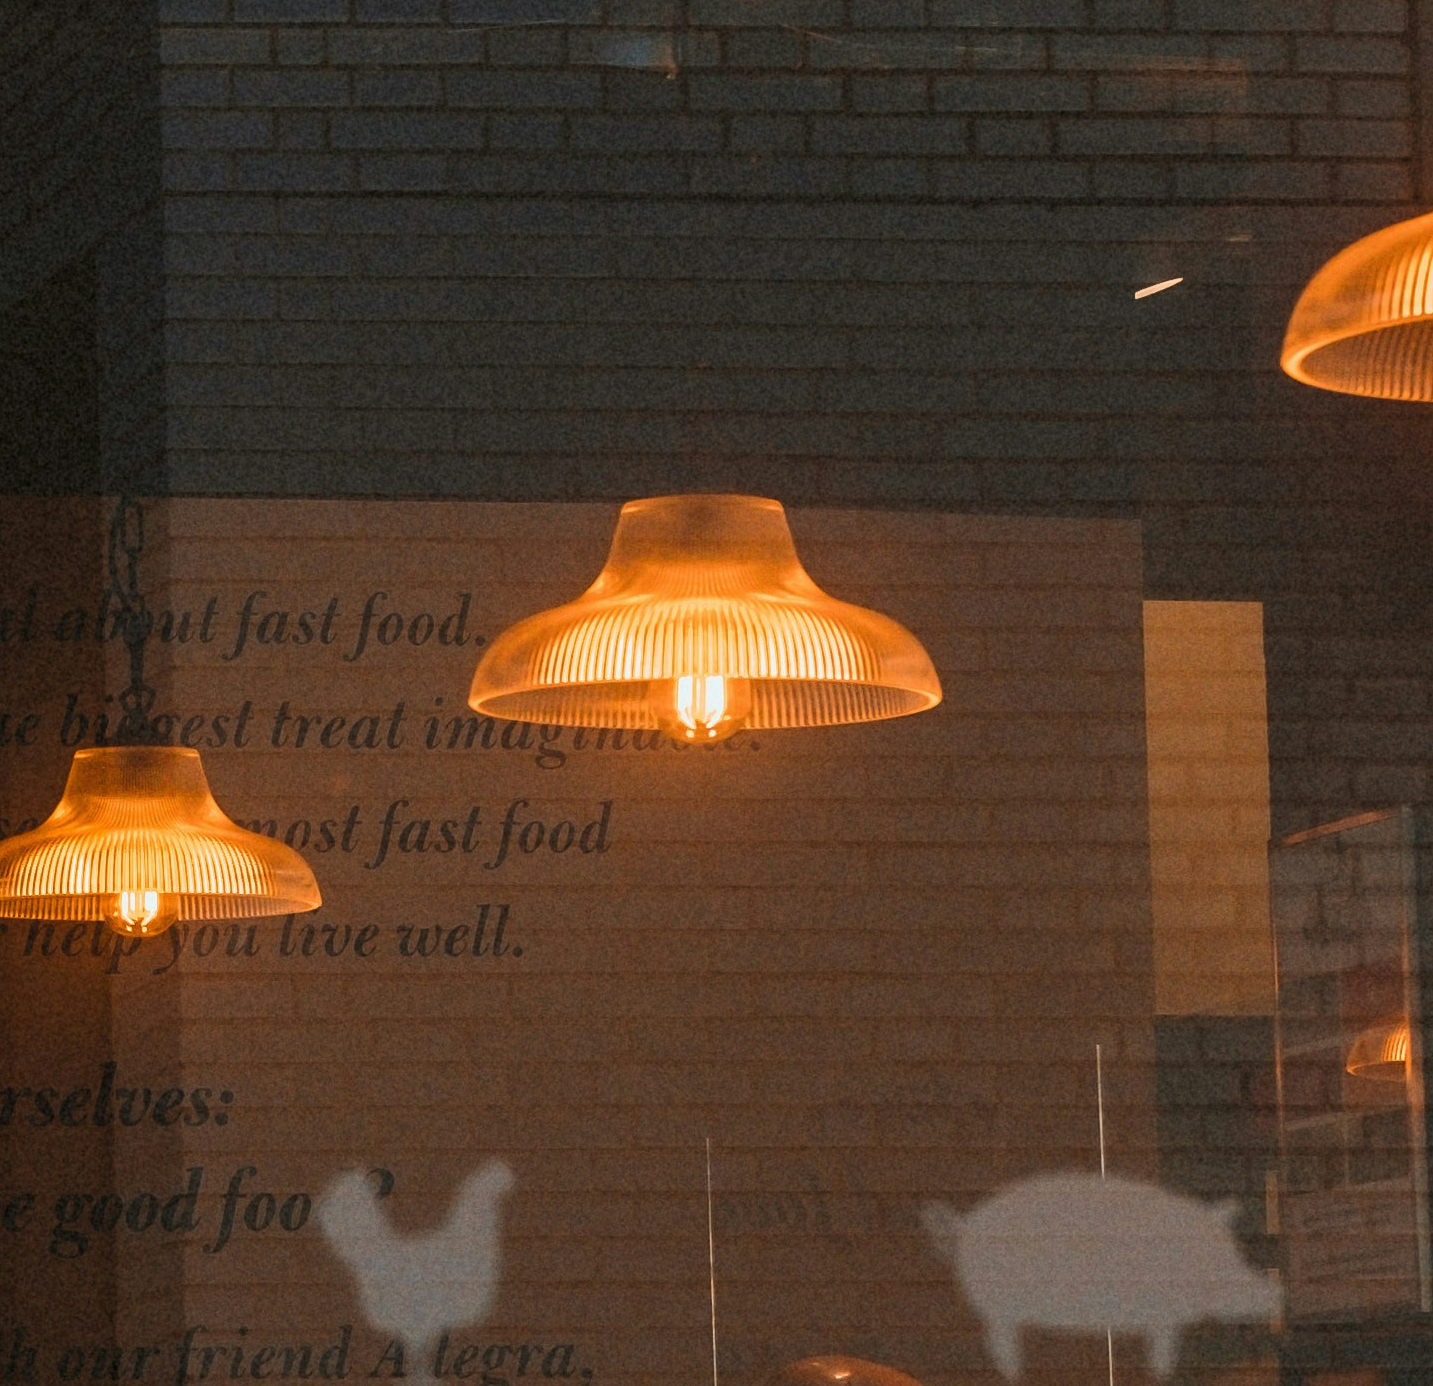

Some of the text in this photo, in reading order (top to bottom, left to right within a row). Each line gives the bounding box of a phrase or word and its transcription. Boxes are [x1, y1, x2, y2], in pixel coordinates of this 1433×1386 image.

[223, 589, 341, 662] fast
[341, 589, 488, 662] food.
[270, 698, 405, 752] treat
[365, 799, 491, 870] fast
[487, 799, 614, 870] food
[153, 921, 262, 976] you
[395, 903, 527, 960] well.
[49, 1165, 201, 1257] good
[57, 1341, 157, 1383] our
